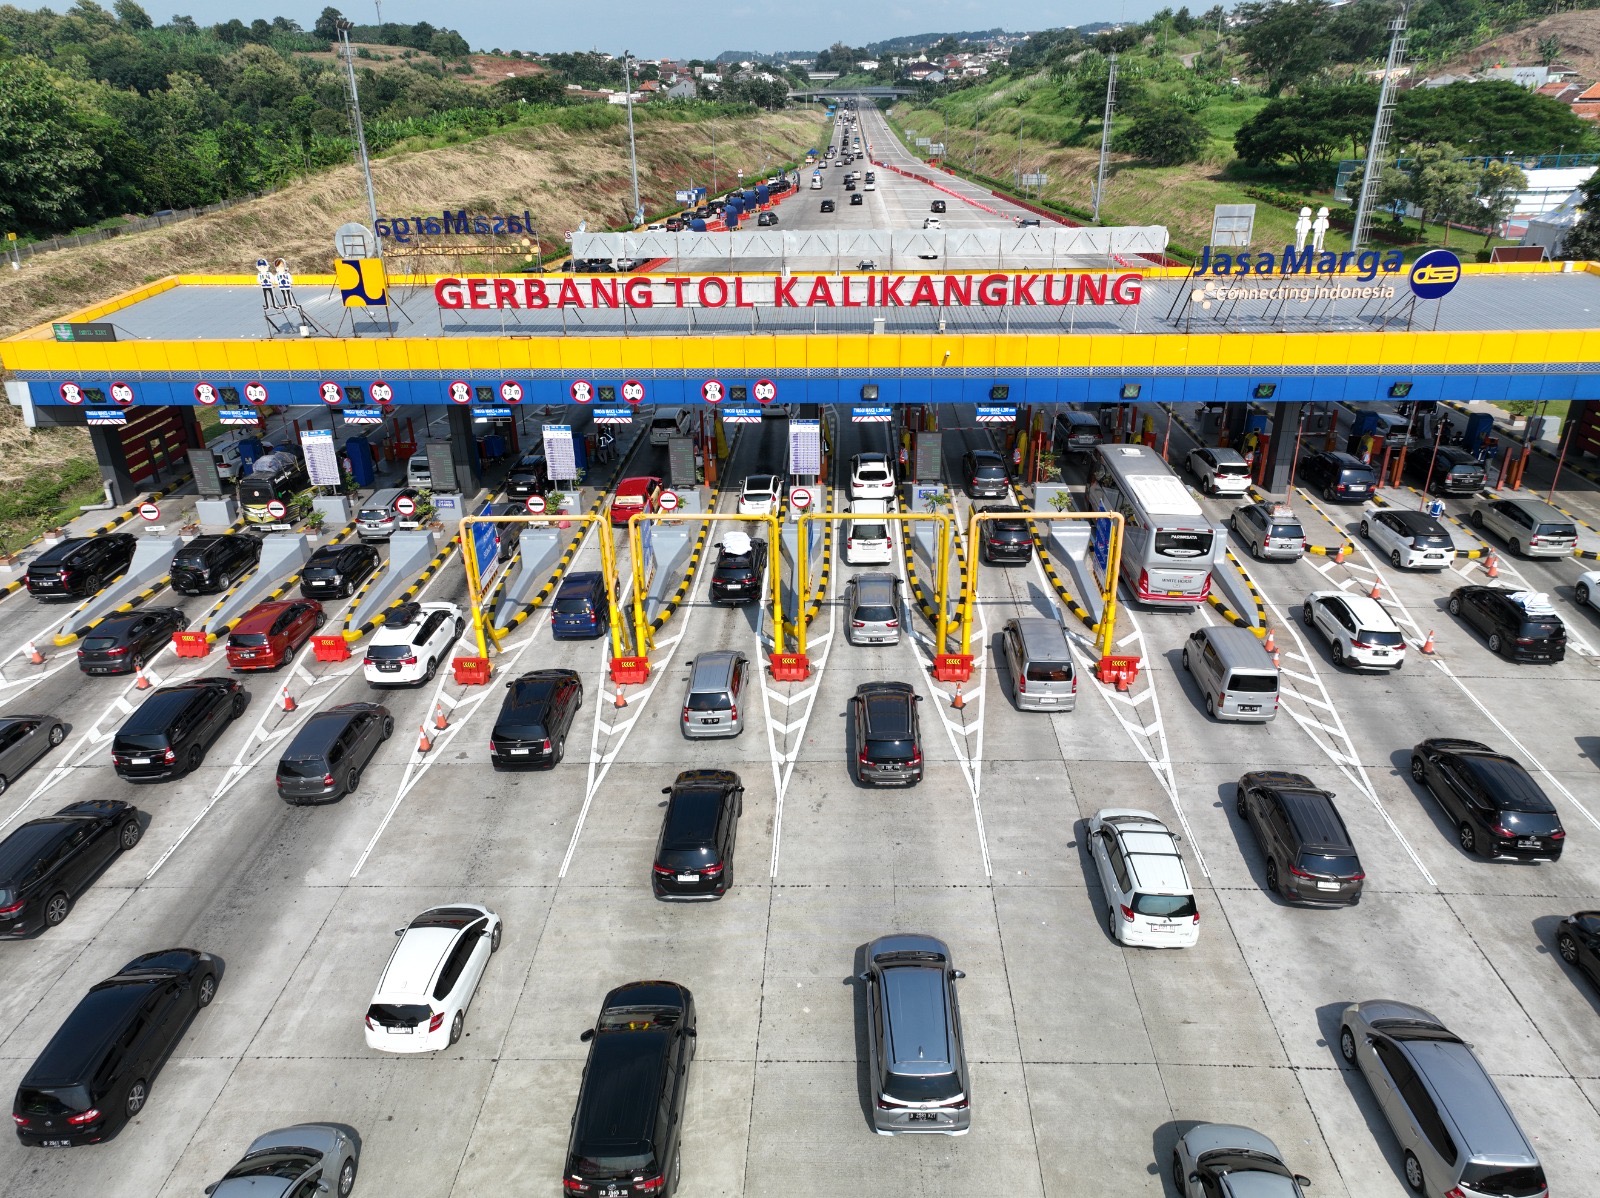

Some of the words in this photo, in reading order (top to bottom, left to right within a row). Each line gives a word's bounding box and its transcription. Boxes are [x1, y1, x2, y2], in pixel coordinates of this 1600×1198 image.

[434, 277, 653, 309] GERBANG
[666, 276, 754, 308] TOL
[774, 273, 1143, 307] KALIKANGKUNG
[1216, 285, 1310, 303] Connecting
[1314, 283, 1395, 299] Indonesia
